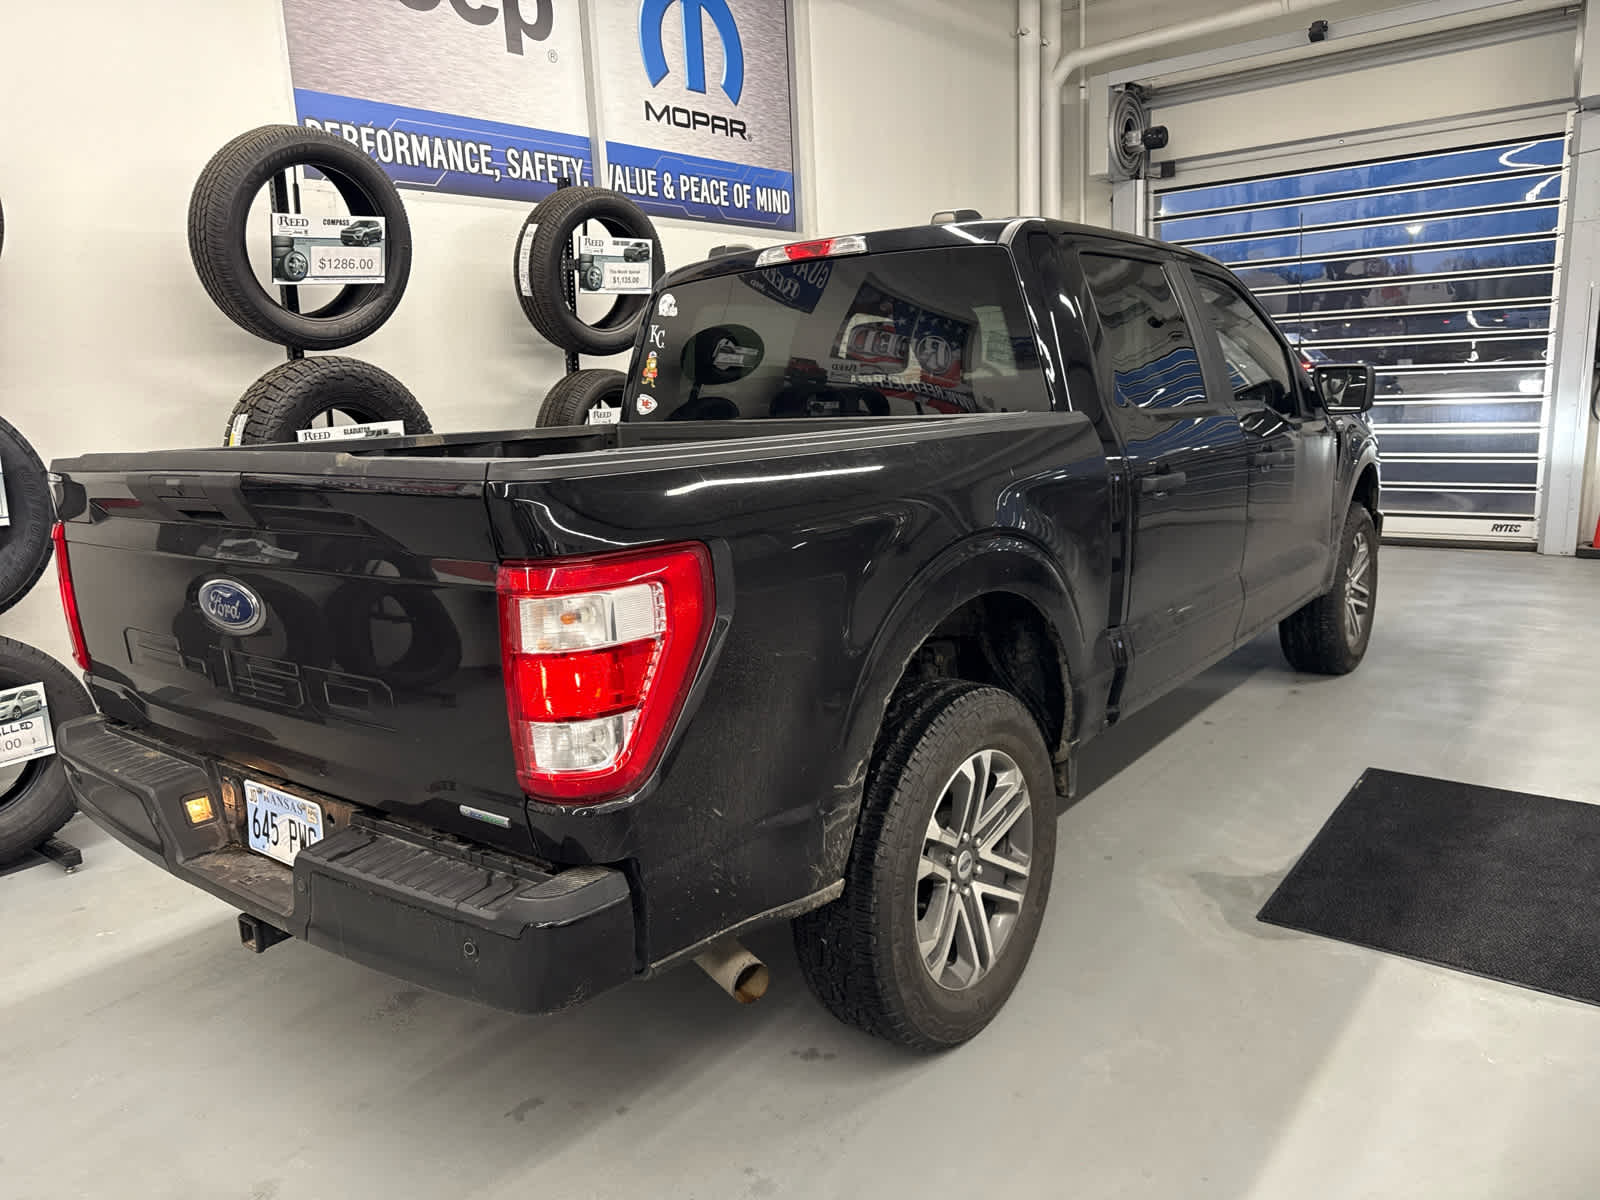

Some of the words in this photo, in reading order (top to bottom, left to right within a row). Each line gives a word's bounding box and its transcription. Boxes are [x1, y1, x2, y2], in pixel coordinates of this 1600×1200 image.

[644, 100, 747, 141] MOPAR
[304, 117, 501, 182] RFORMANCE,
[663, 172, 676, 200] &
[679, 174, 729, 207] PEACE
[733, 183, 751, 209] OF
[756, 186, 791, 215] MIND
[322, 218, 351, 227] COMPASS
[317, 256, 374, 271] $1286.00
[649, 324, 666, 349] KC
[1491, 523, 1521, 532] RYTEC
[208, 589, 241, 619] Ford
[263, 790, 305, 815] KANSAS
[252, 806, 279, 847] 645
